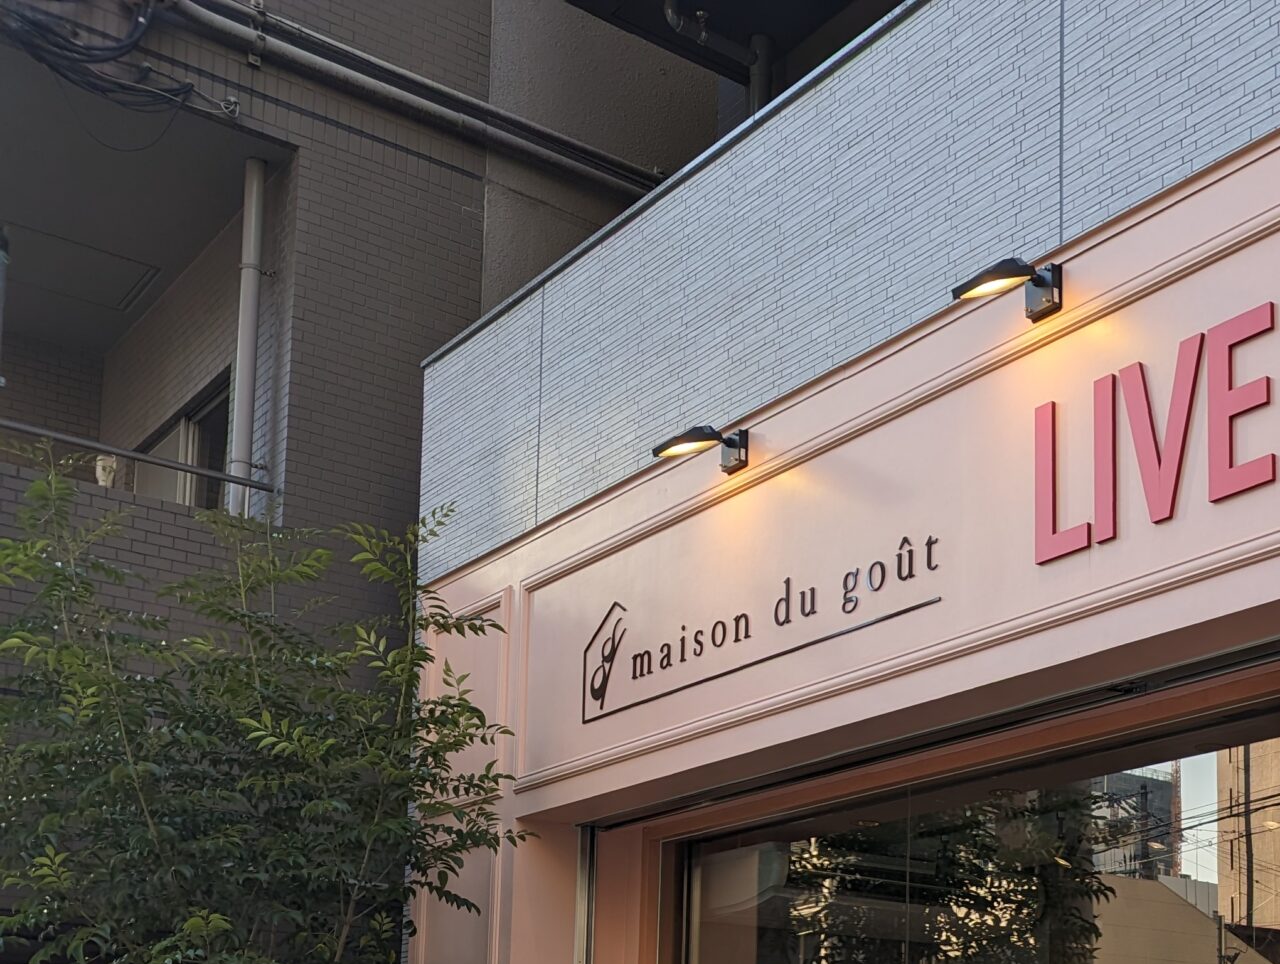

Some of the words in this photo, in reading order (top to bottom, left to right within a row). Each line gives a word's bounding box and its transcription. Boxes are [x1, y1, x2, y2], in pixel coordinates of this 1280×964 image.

[1034, 301, 1276, 565] LIVE
[631, 611, 752, 680] maison
[773, 577, 818, 627] du
[841, 535, 940, 615] goût
